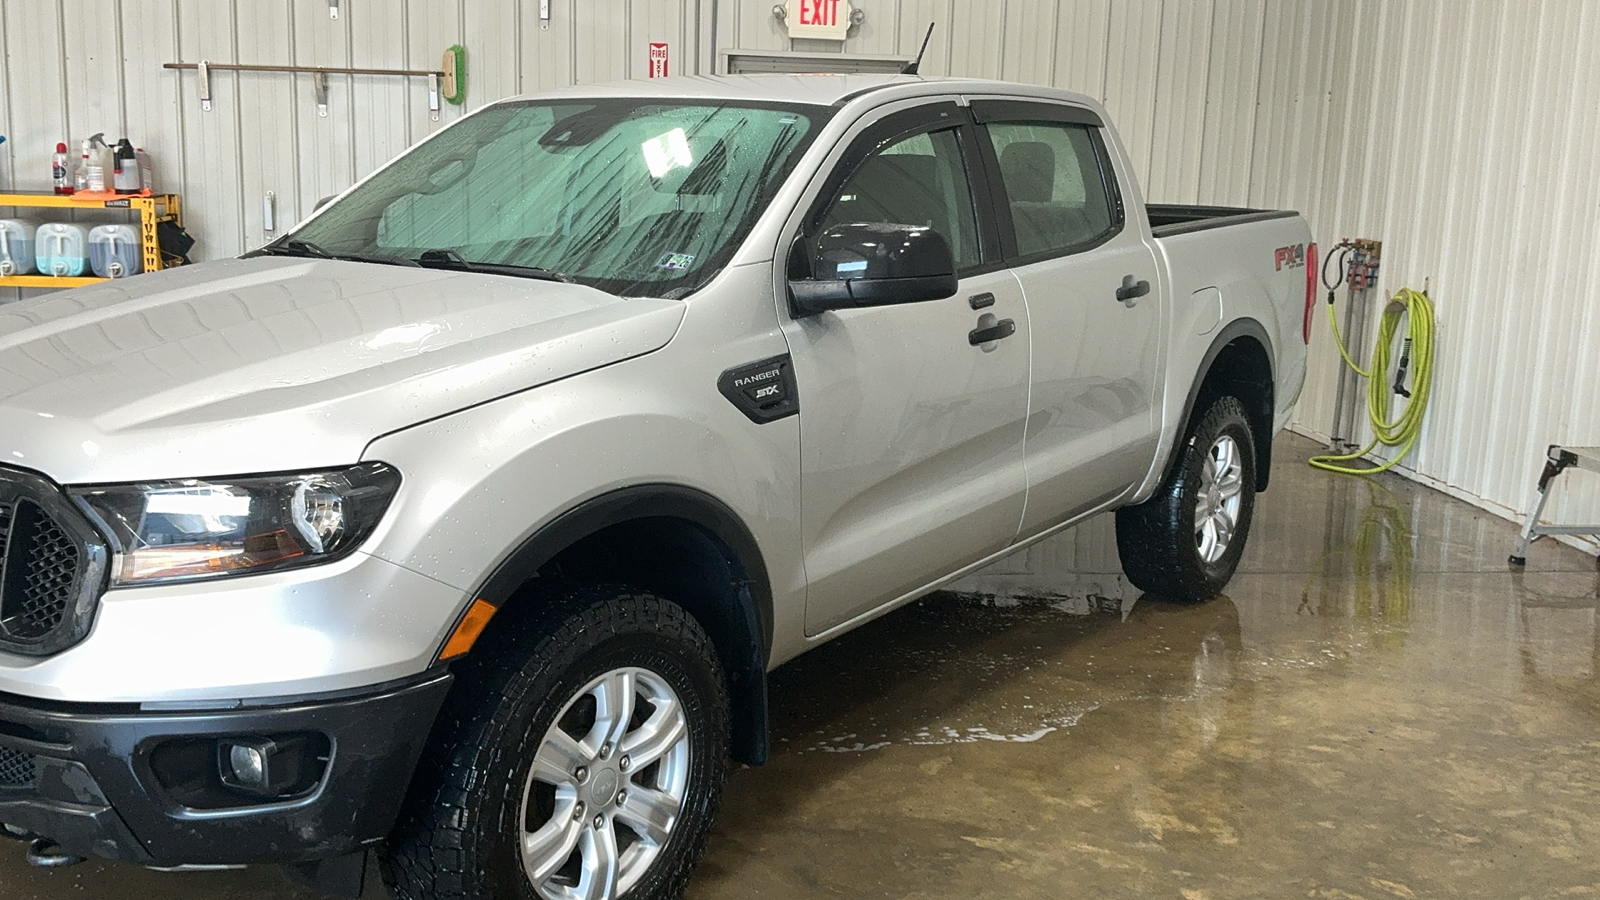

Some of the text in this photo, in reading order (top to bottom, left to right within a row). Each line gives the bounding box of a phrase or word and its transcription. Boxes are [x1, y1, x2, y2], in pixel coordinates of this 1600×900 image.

[799, 0, 840, 26] EXIT
[652, 49, 666, 58] FIRE
[1274, 243, 1304, 272] FX4
[734, 369, 780, 387] RANGER
[756, 384, 779, 398] STX
